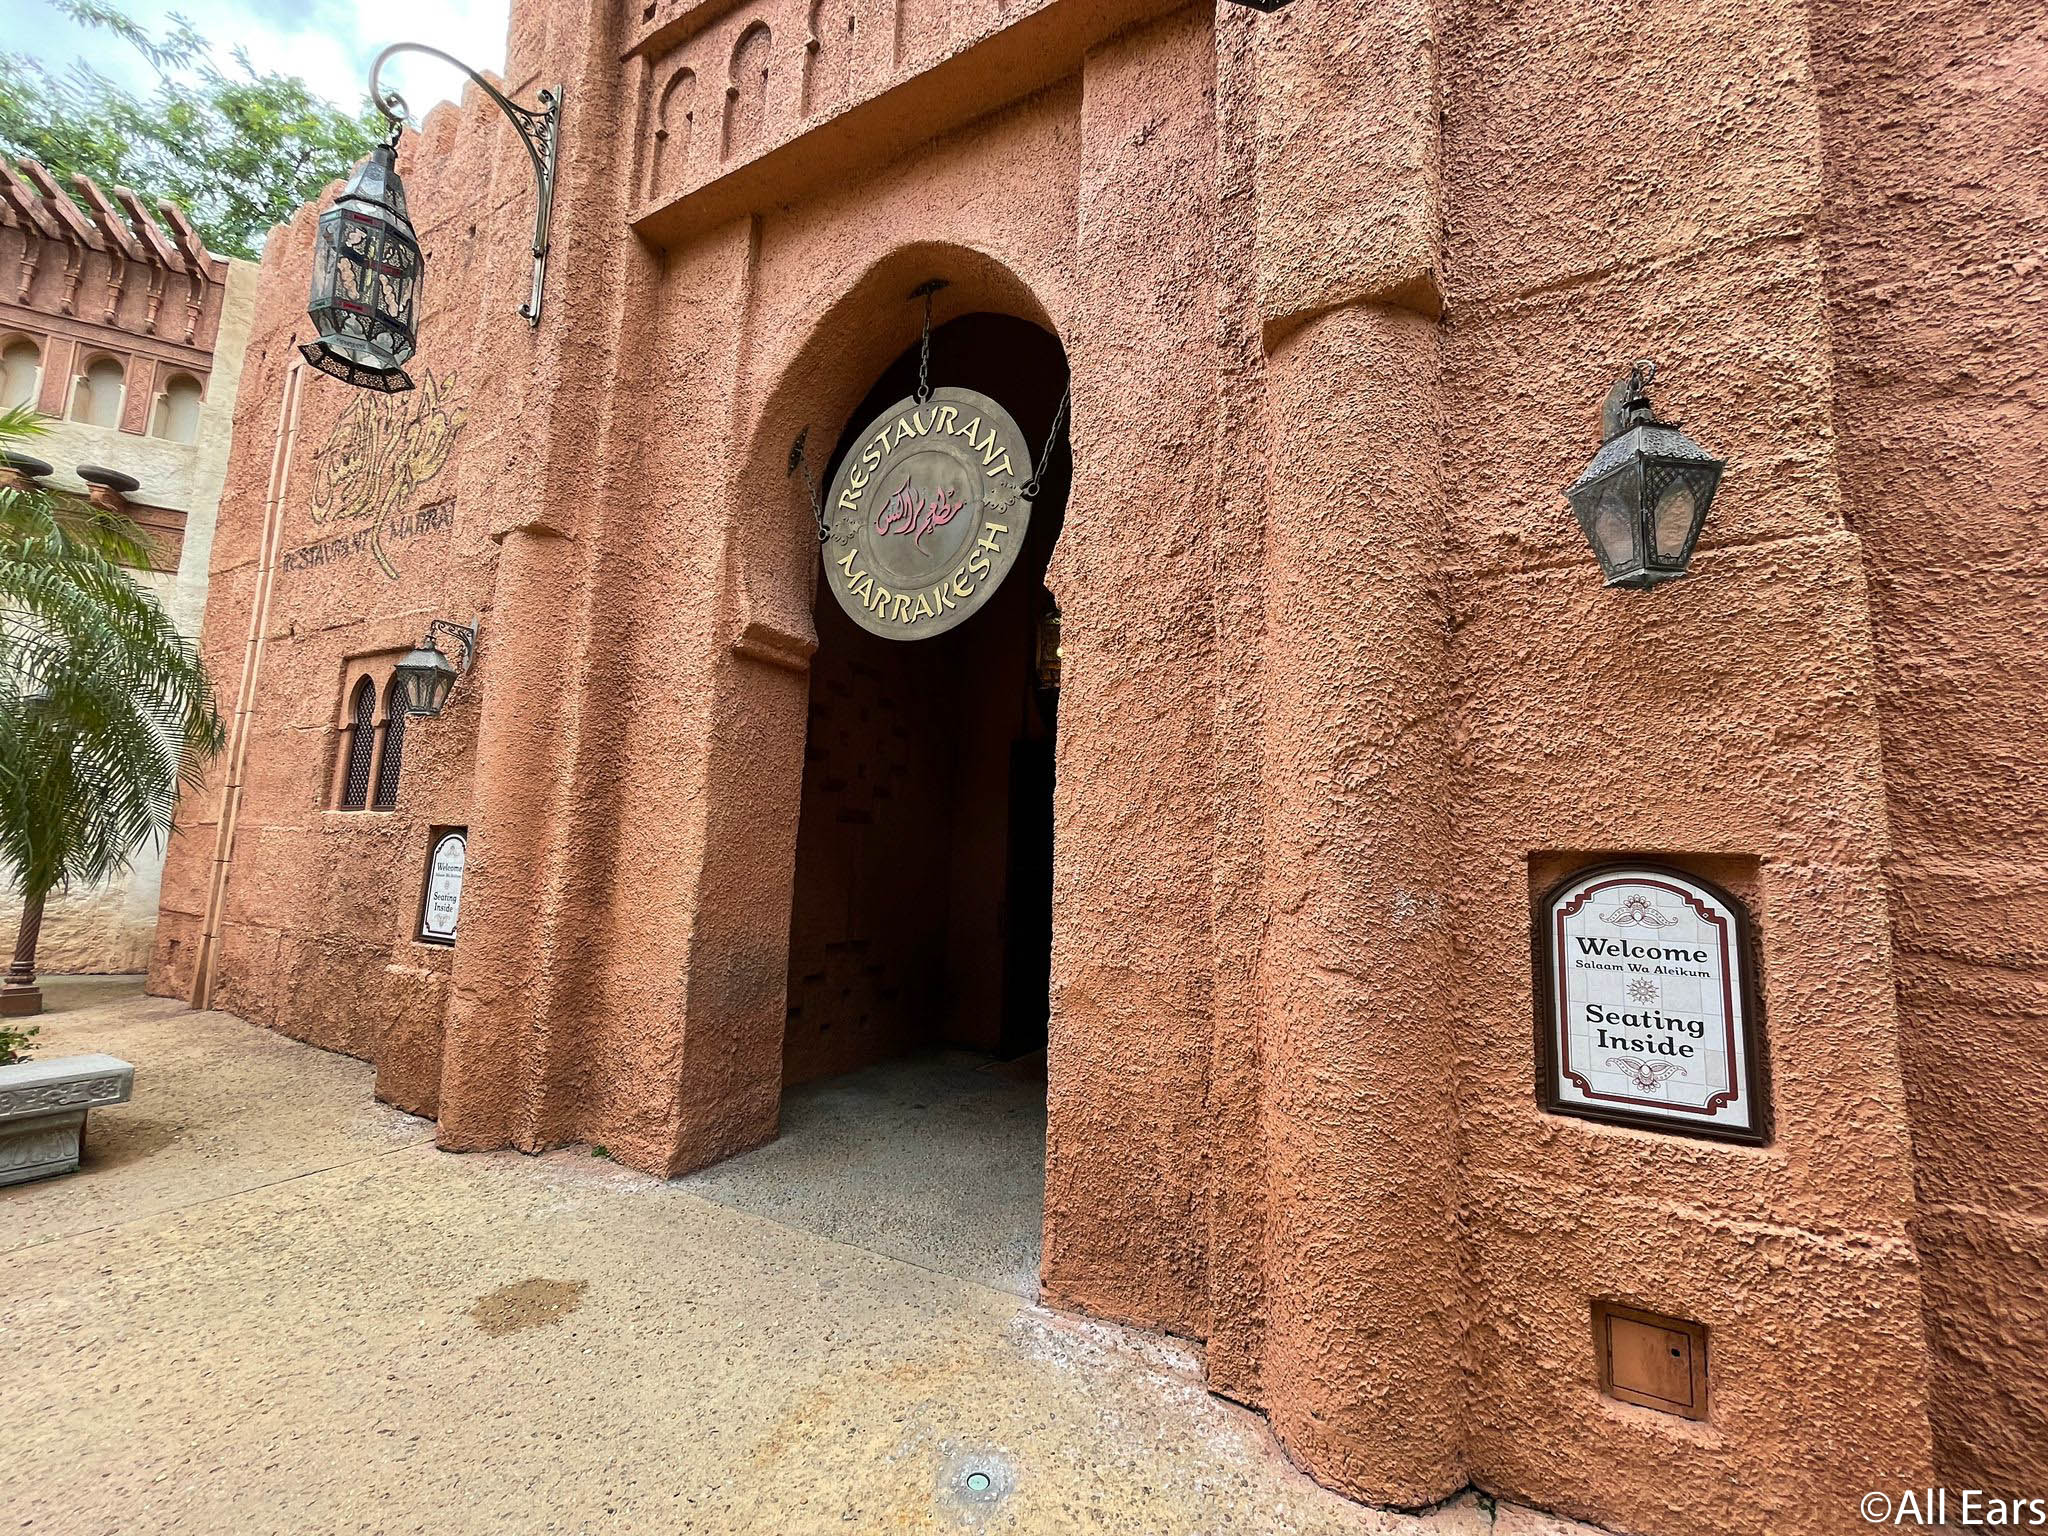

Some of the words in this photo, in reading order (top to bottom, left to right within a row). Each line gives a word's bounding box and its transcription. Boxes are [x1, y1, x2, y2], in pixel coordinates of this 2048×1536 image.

[838, 405, 1015, 512] RESTAURANT
[837, 522, 1009, 625] MARRAKESH
[437, 862, 462, 872] Welcome
[433, 891, 457, 904] Seating
[434, 902, 454, 912] Inside
[1576, 936, 1708, 963] Welcome
[1575, 959, 1624, 972] Salaam
[1627, 963, 1649, 974] Wa
[1653, 965, 1711, 978] Aleikum
[1586, 1004, 1705, 1039] Seating
[1597, 1028, 1694, 1058] Inside
